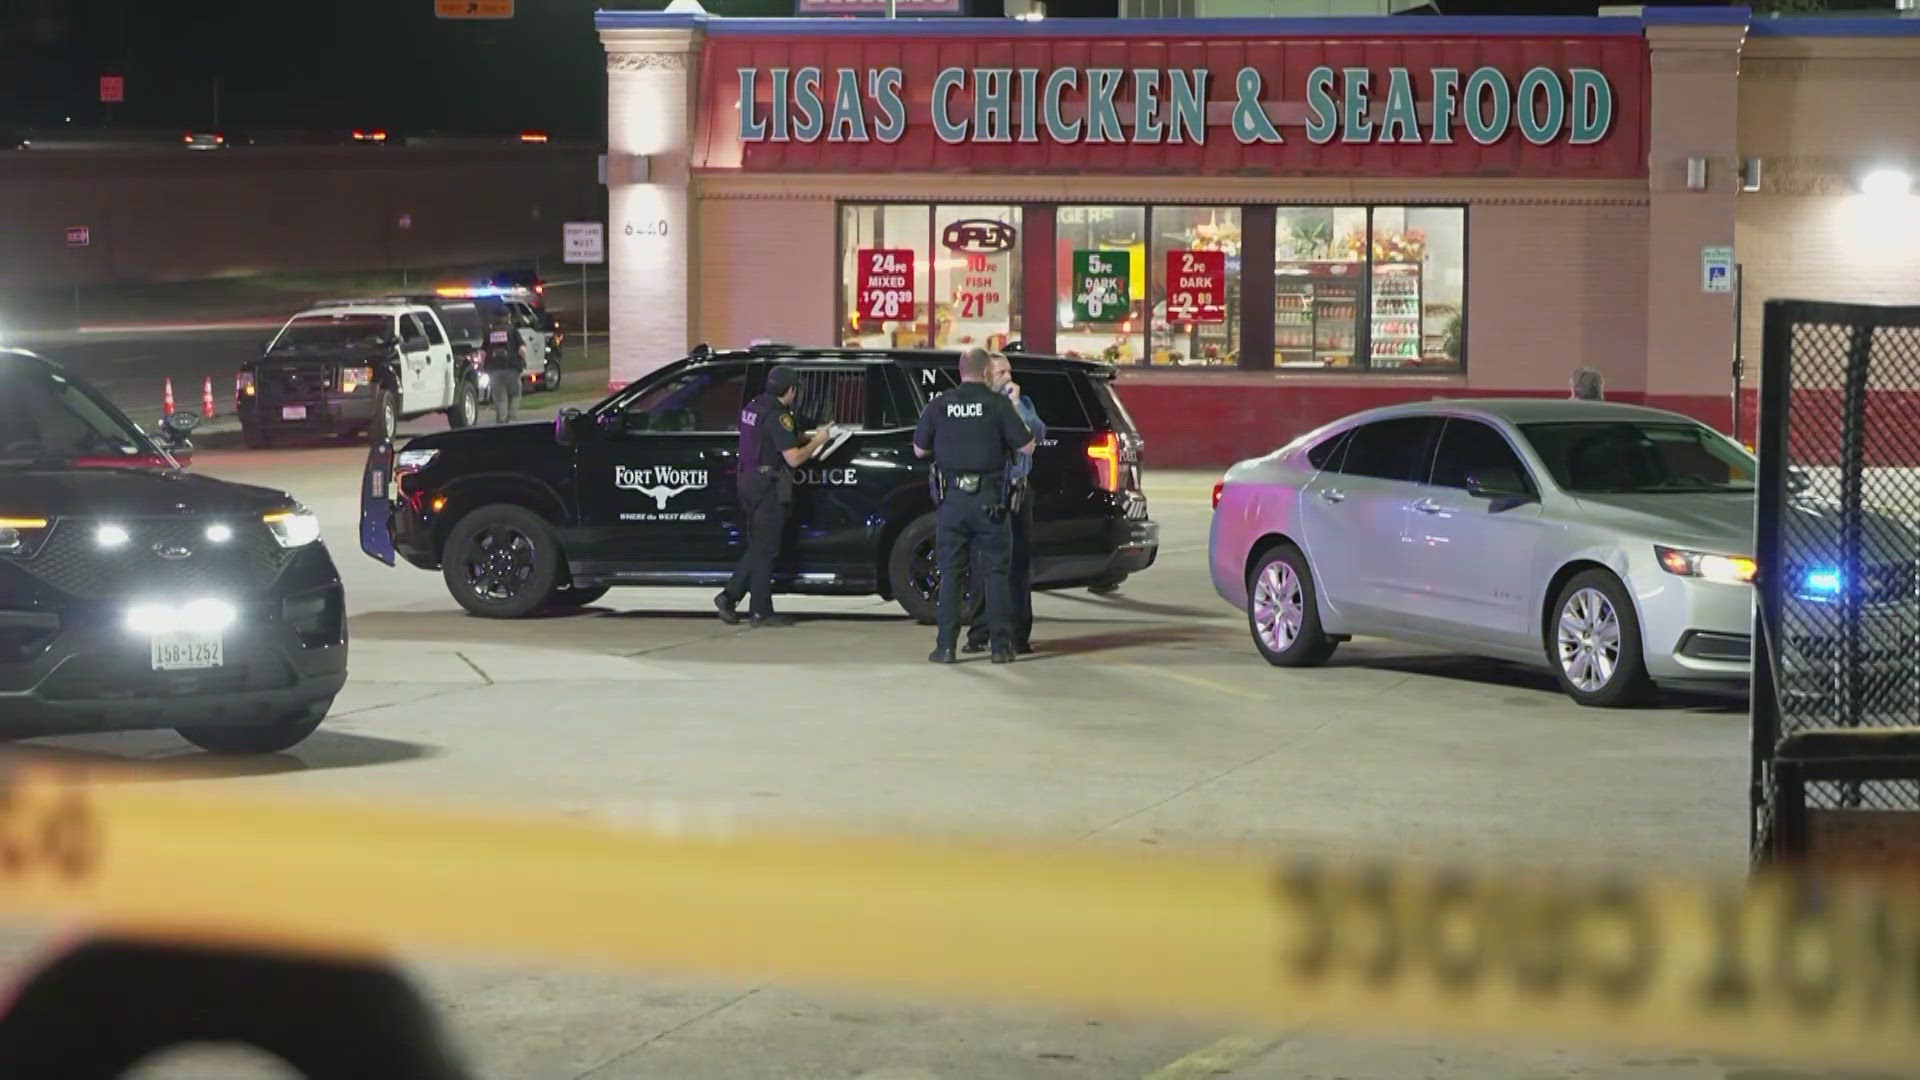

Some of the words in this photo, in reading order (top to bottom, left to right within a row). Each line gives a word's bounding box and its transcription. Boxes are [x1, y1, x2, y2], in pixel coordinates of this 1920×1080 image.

[736, 66, 906, 143] LISA'S
[931, 66, 1209, 144] CHICKEN
[1232, 66, 1284, 143] &
[1305, 66, 1612, 144] SEAFOOD
[867, 275, 905, 288] MIXED
[966, 277, 992, 288] FISH
[1085, 277, 1118, 289] DARK
[1179, 277, 1213, 288] DARK
[921, 369, 936, 385] N
[947, 403, 983, 417] POLICE
[615, 465, 652, 485] FORT
[654, 465, 708, 485] WORTH
[792, 468, 858, 485] OLICE
